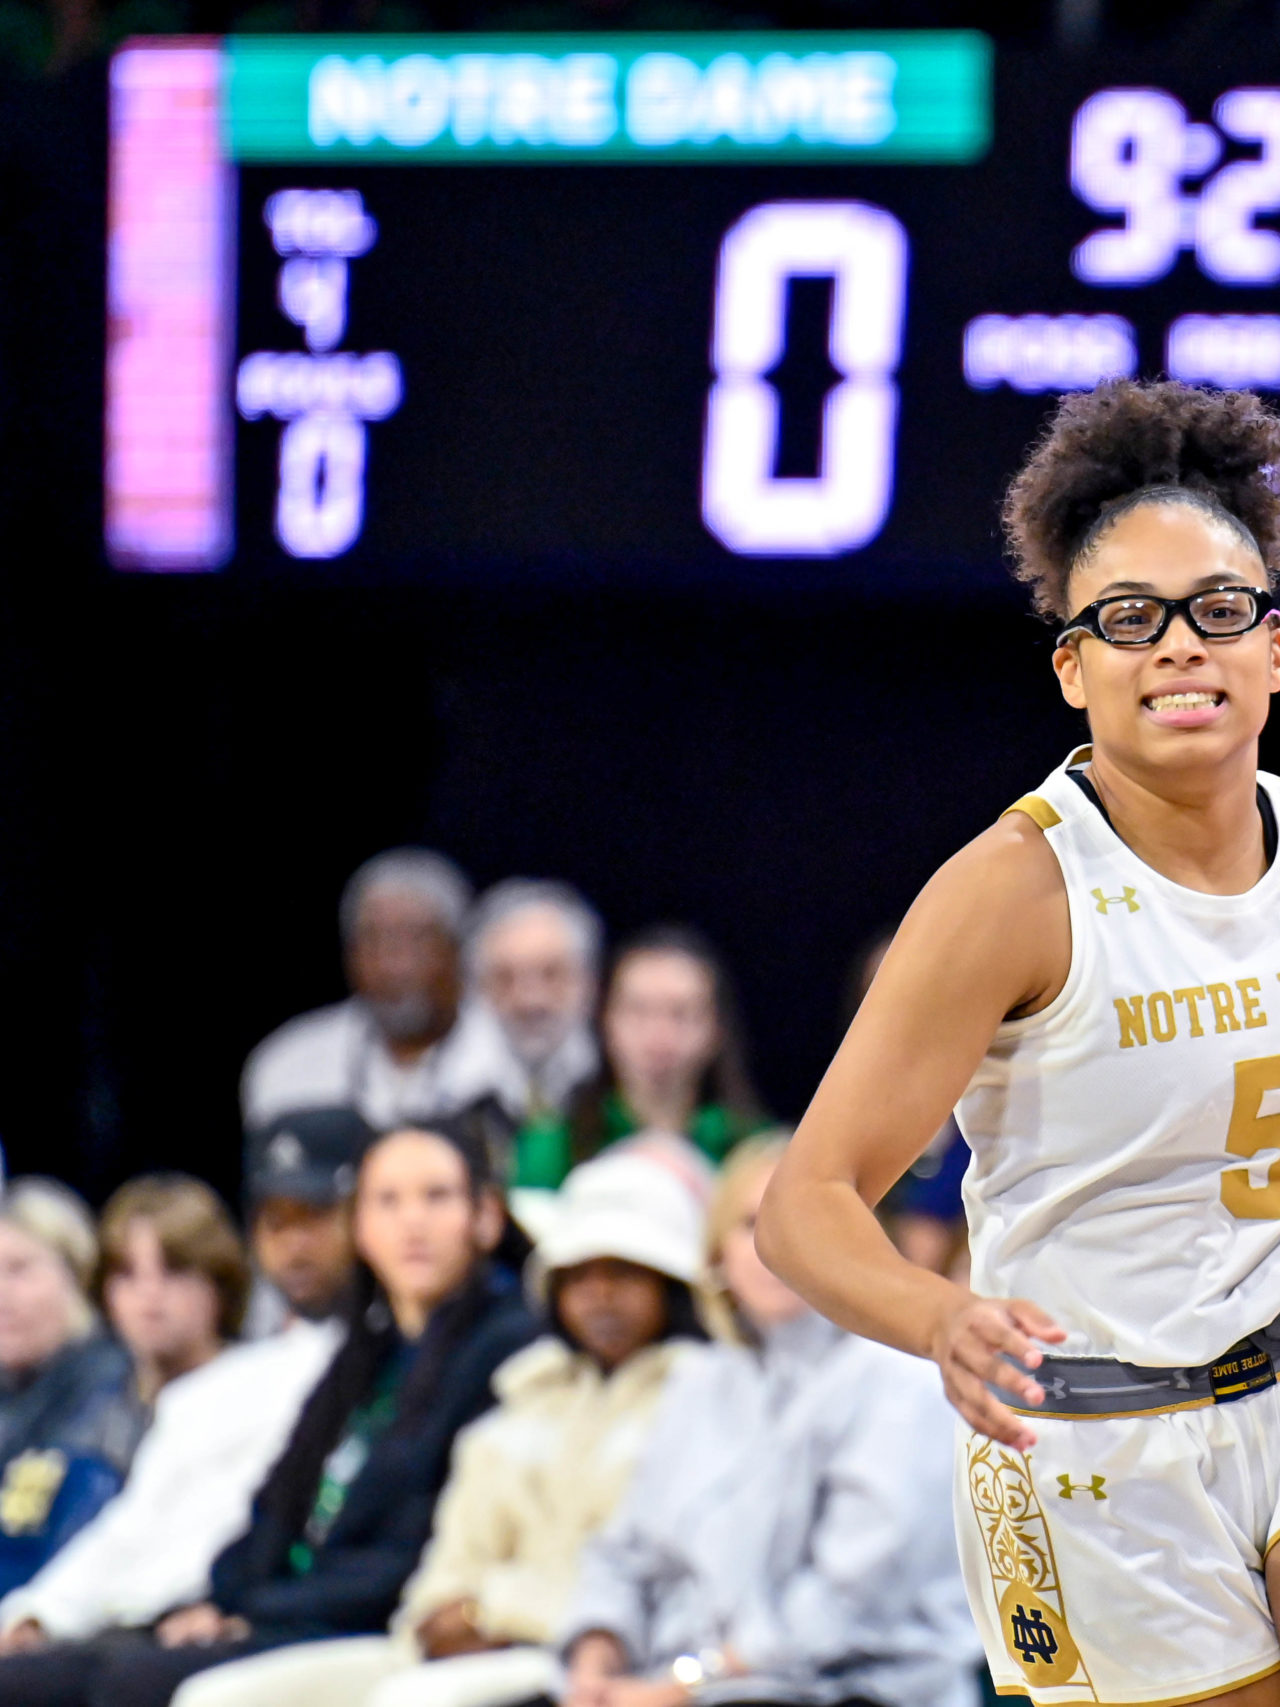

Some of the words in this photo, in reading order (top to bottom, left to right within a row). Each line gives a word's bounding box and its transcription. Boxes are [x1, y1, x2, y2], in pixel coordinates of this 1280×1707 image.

[309, 54, 616, 145] NOTRE
[627, 53, 893, 143] DAME
[702, 203, 907, 556] 0
[276, 414, 365, 557] 0
[1113, 977, 1267, 1049] NOTRE
[1213, 1361, 1240, 1377] DAME
